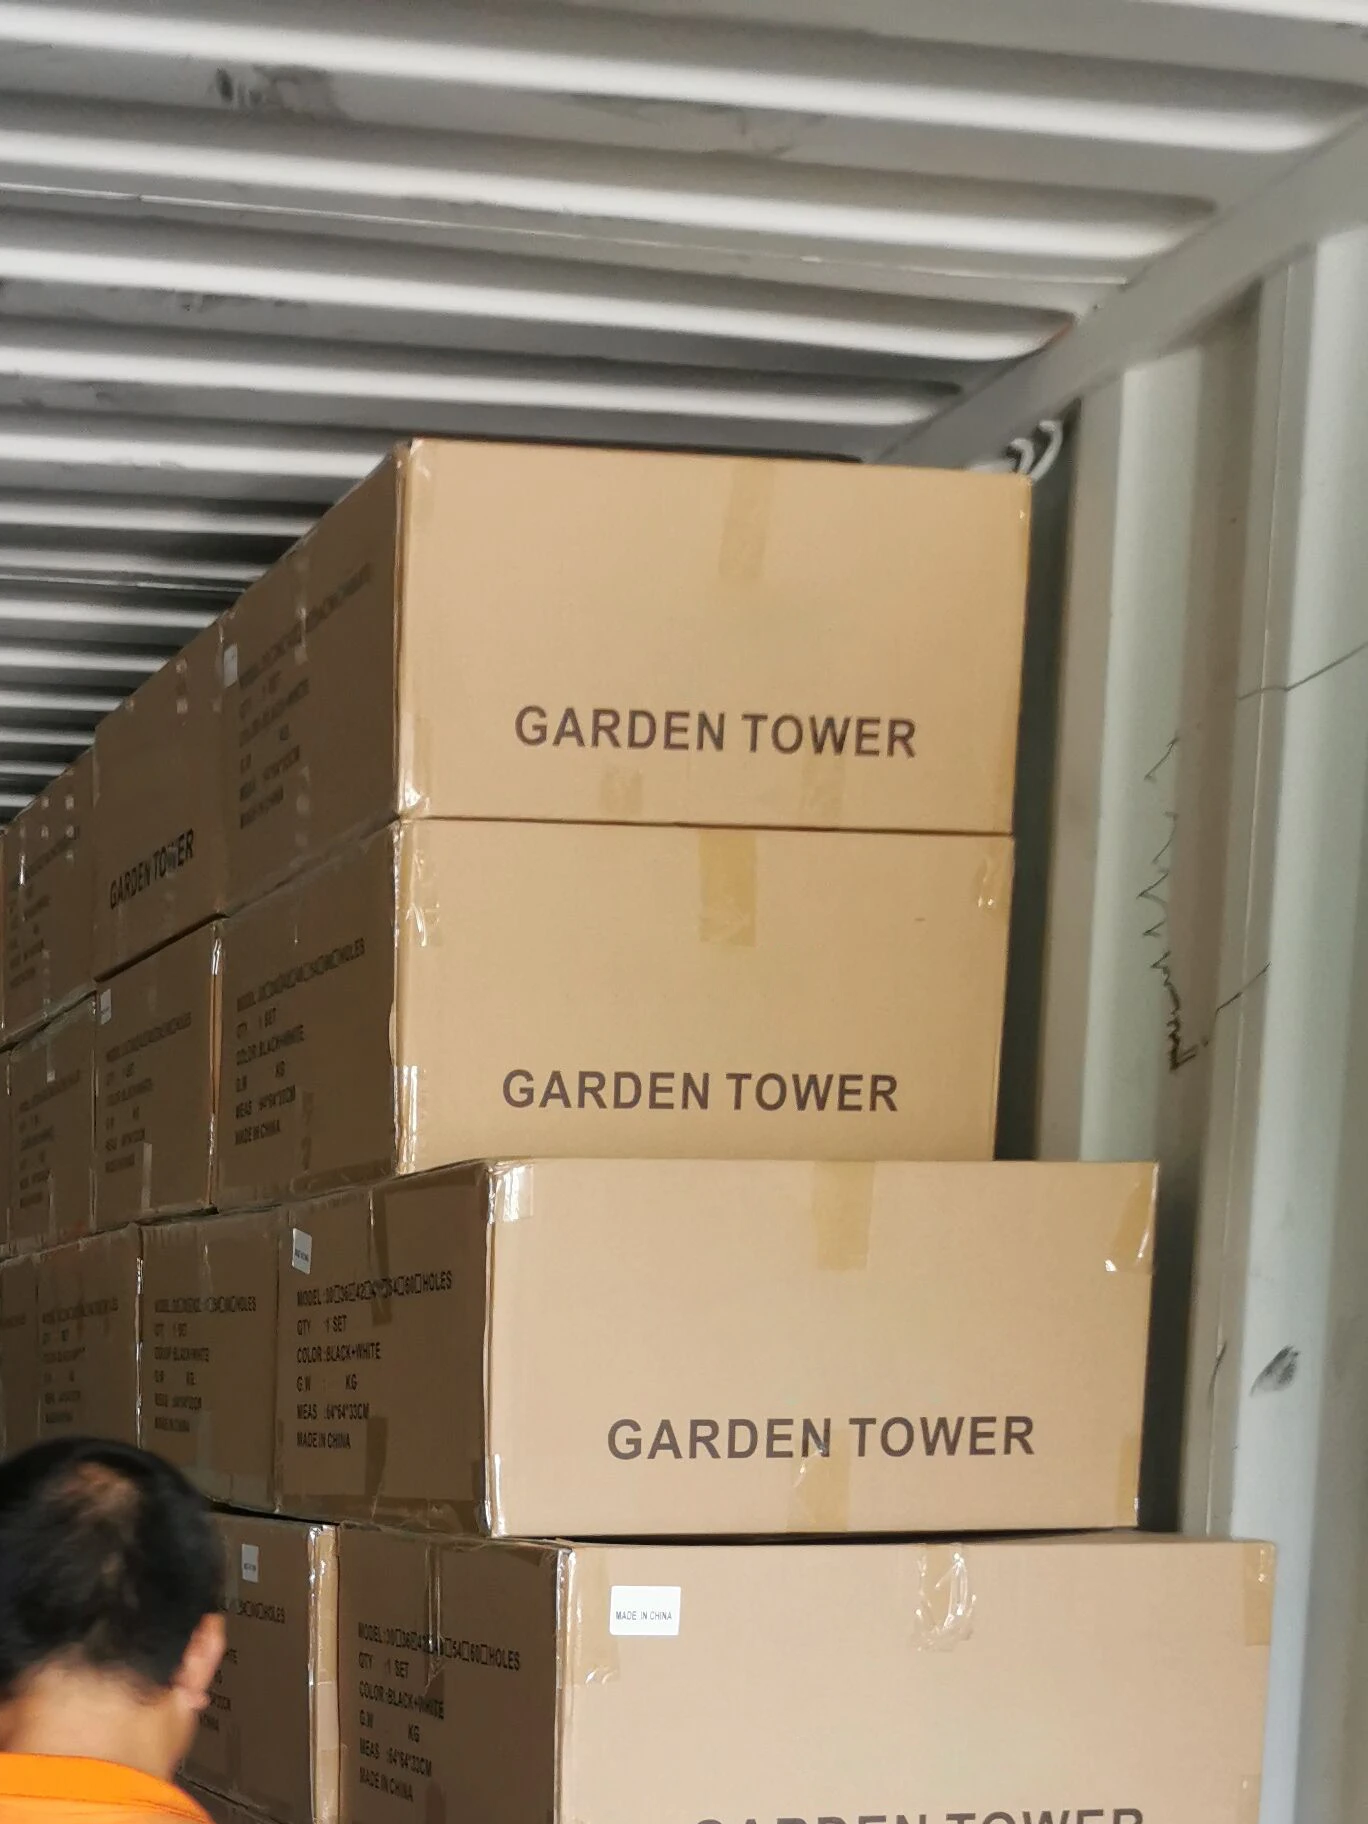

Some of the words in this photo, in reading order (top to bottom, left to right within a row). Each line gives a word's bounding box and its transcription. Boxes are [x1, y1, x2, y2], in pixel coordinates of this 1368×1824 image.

[514, 705, 725, 751] GARDEN
[741, 713, 916, 758] TOWER
[110, 861, 151, 910] GARDEN
[153, 828, 194, 880] TOWER
[502, 1069, 710, 1110] GARDEN
[725, 1072, 898, 1112] TOWER
[296, 1319, 311, 1336] QTY
[332, 1315, 348, 1333] SET
[345, 1373, 358, 1391] KG
[296, 1403, 318, 1420] MEAS
[296, 1431, 318, 1448] MADE
[319, 1432, 327, 1448] IN
[327, 1432, 352, 1449] CHINA
[607, 1417, 831, 1461] GARDEN
[848, 1415, 1035, 1458] TOWER
[615, 1610, 637, 1621] MADE
[640, 1610, 648, 1621] IN
[649, 1610, 673, 1621] CHINA
[358, 1651, 373, 1670] QTY
[395, 1658, 410, 1679] SET
[408, 1723, 420, 1743] KG
[359, 1736, 380, 1760] MEAS
[359, 1766, 380, 1789] MADE
[380, 1773, 389, 1794] IN
[389, 1777, 414, 1803] CHINA
